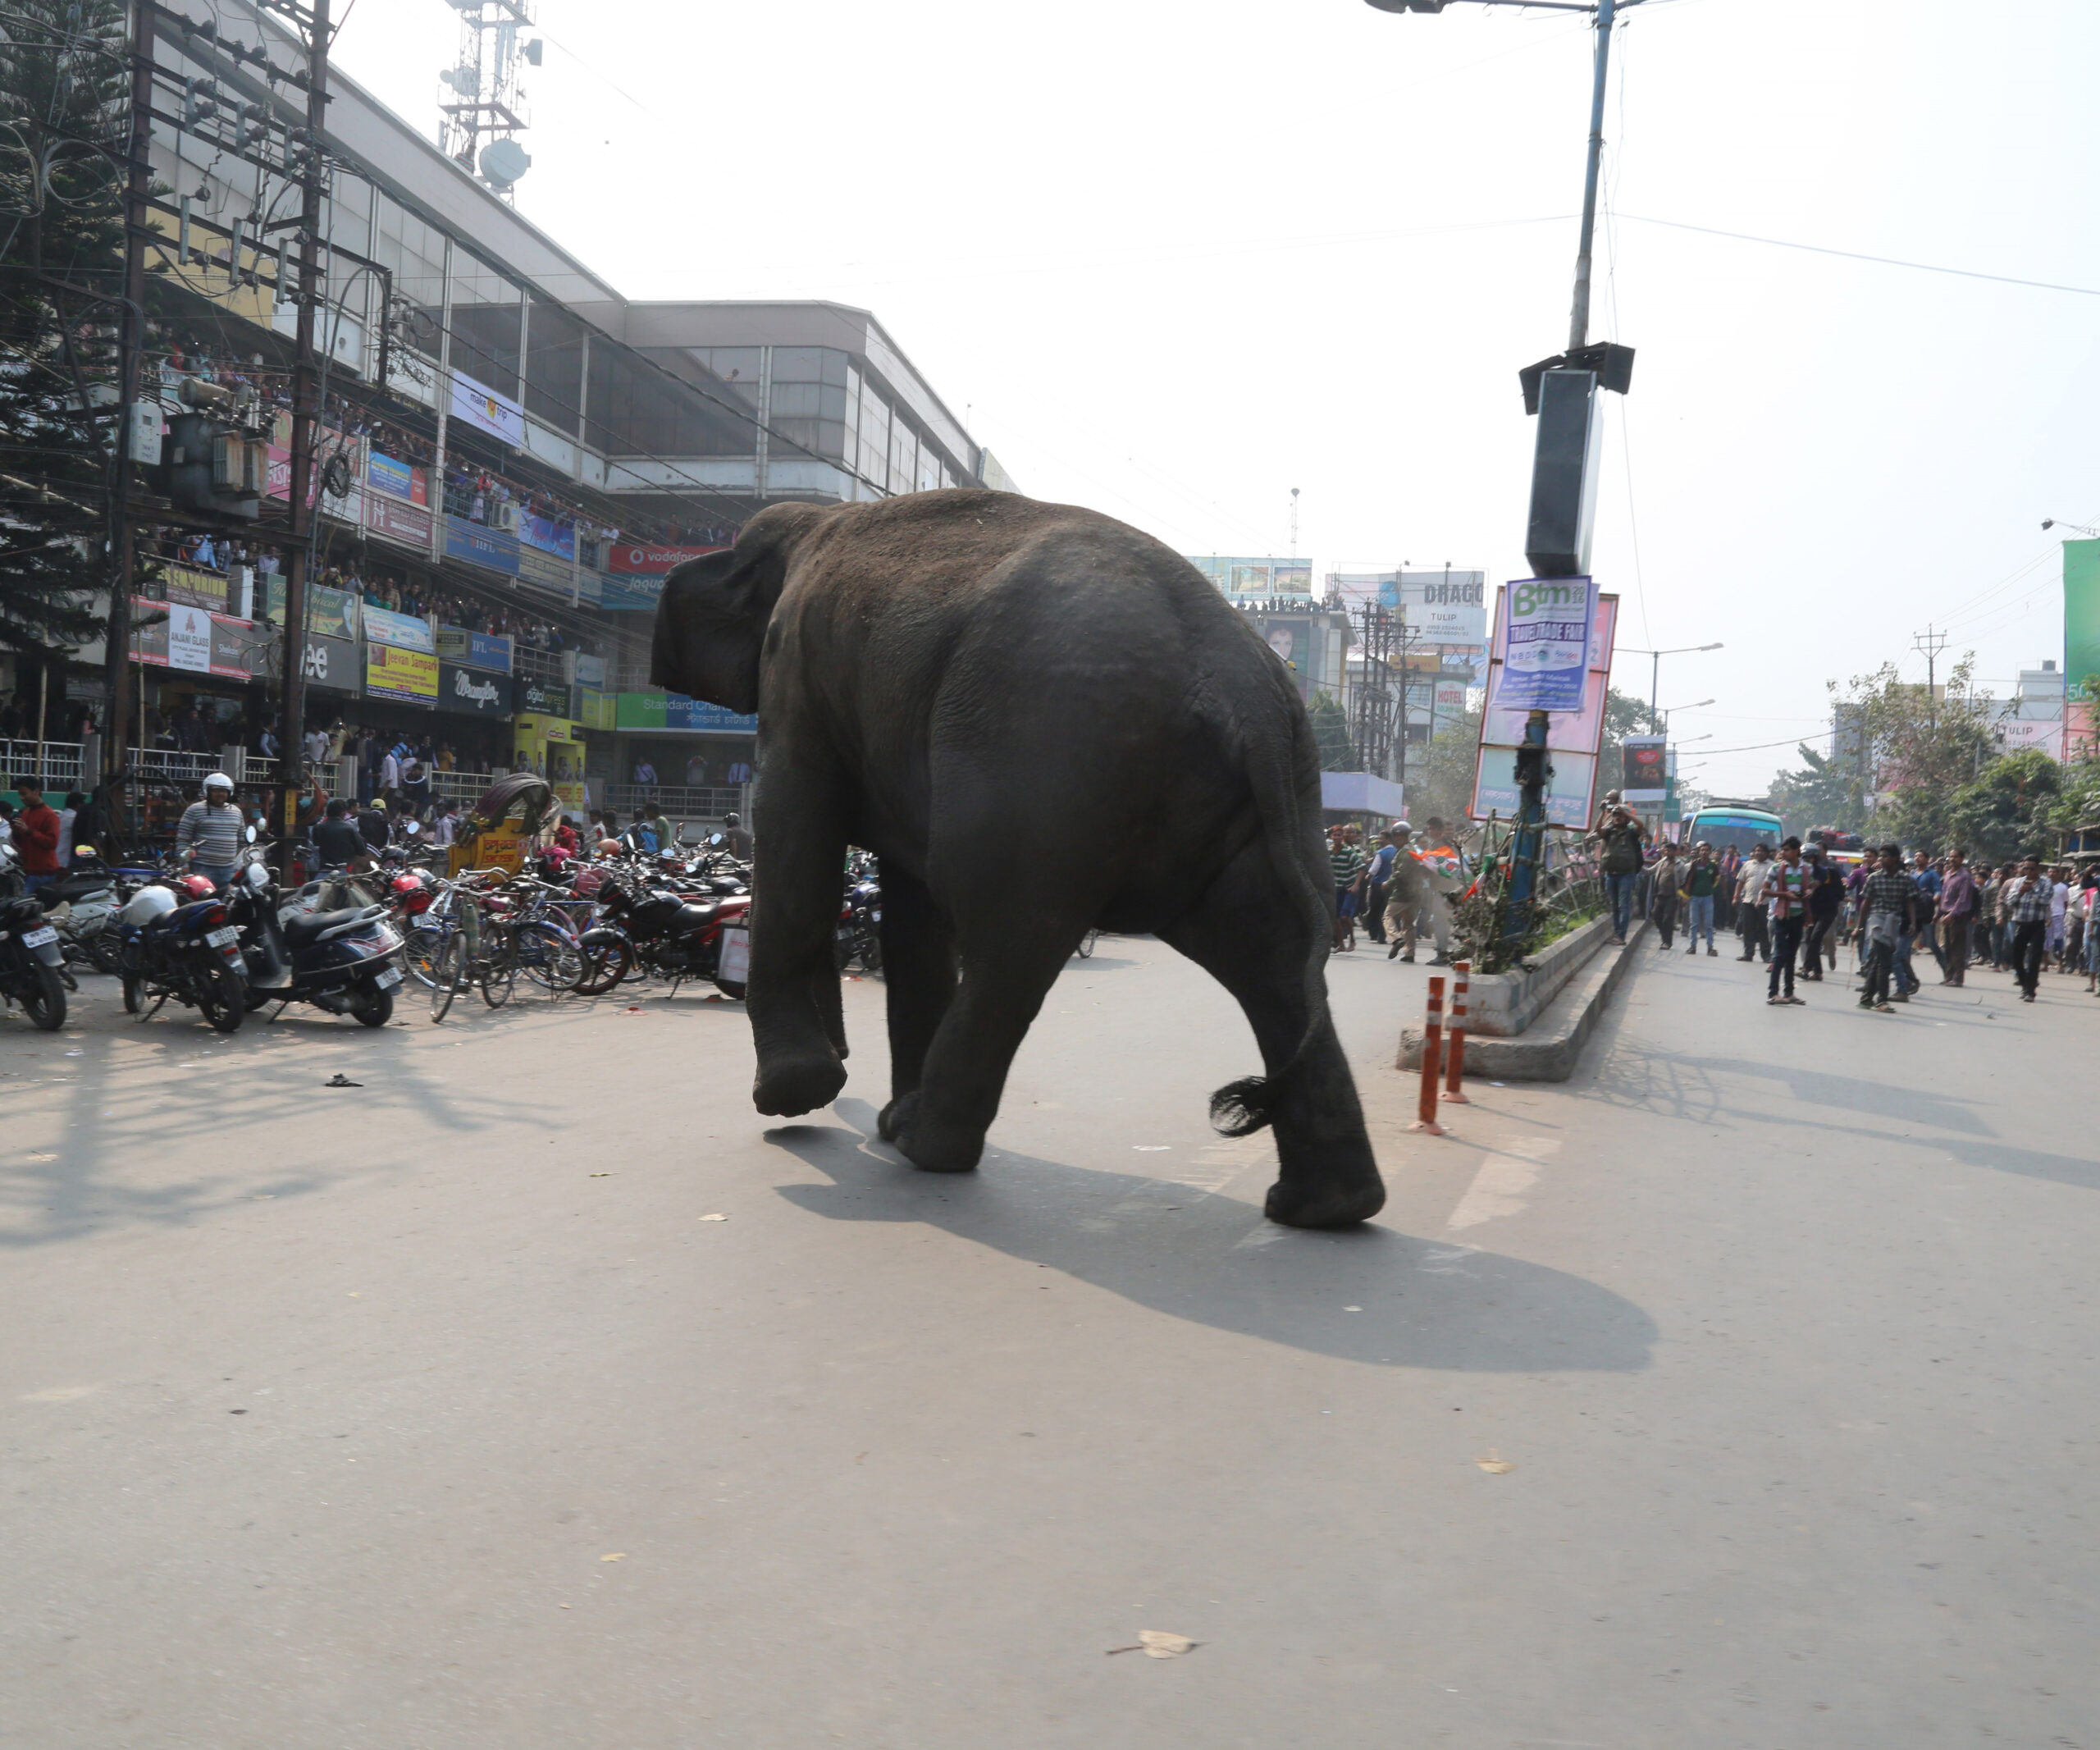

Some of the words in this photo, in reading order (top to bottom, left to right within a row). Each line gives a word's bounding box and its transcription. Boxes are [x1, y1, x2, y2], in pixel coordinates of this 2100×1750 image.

[470, 392, 486, 408] make
[497, 406, 507, 422] trip
[647, 550, 701, 564] vodafon
[173, 569, 227, 597] EMPORIUM
[1513, 583, 1570, 617] Btm
[1431, 612, 1457, 622] TULIP
[171, 632, 191, 645] ANJANI
[192, 636, 209, 648] GLASS
[1536, 622, 1564, 641] TRADE
[1564, 624, 1584, 641] FAIR
[387, 649, 409, 666] Jeevan
[411, 654, 437, 674] Sampark
[455, 669, 500, 709] Wrangler
[1437, 690, 1463, 704] HOTEL
[643, 698, 693, 711] Standard
